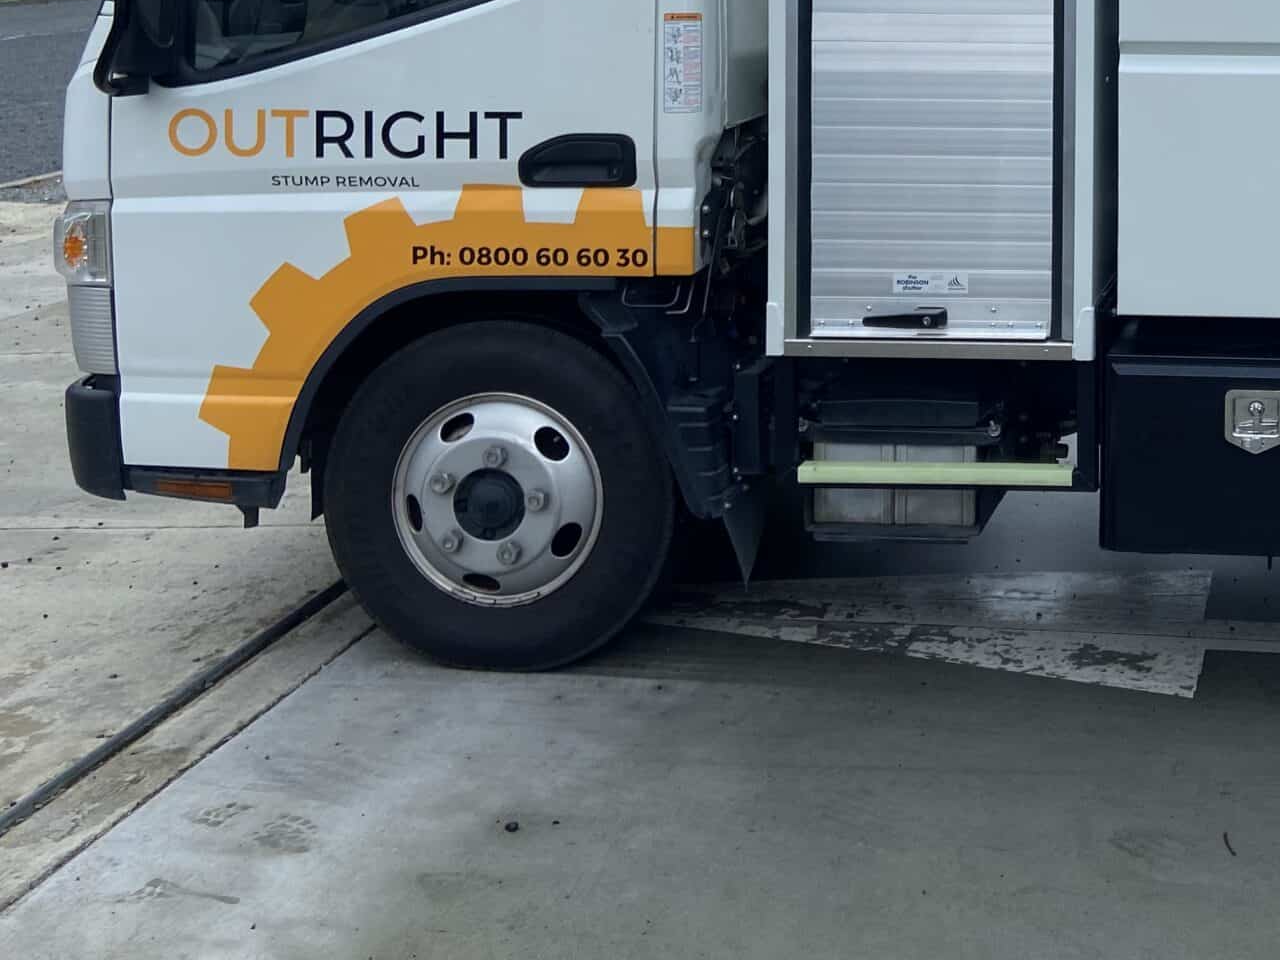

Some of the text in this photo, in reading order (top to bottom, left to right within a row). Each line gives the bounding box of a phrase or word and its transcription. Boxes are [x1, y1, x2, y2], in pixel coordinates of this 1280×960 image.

[167, 107, 523, 160] OUTRIGHT
[271, 175, 420, 188] STUMP REMOVAL
[412, 246, 649, 268] Ph: 0800 60 60 30
